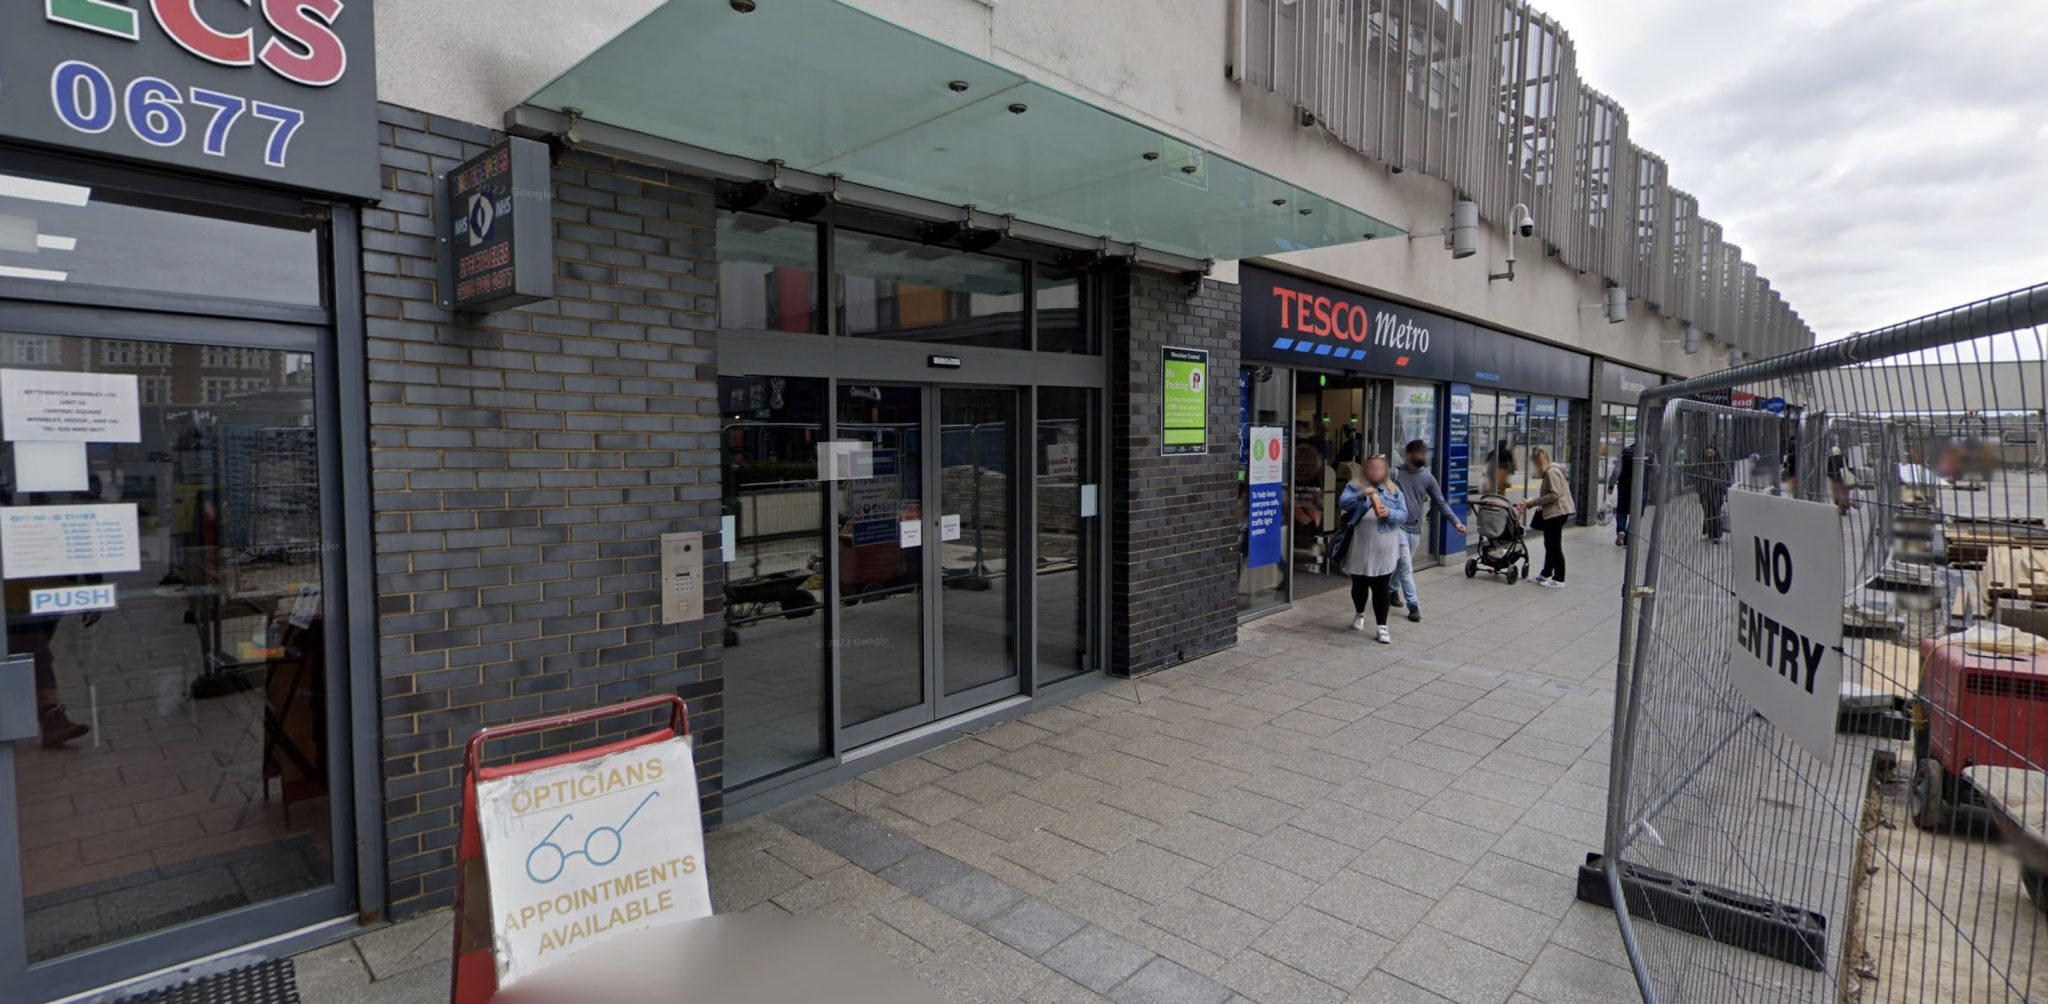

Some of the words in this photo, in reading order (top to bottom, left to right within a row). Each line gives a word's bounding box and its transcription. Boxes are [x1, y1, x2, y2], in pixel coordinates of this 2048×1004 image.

[51, 60, 304, 168] 0677
[454, 217, 468, 236] NHS
[495, 196, 512, 218] NHS
[1272, 286, 1368, 343] TESCO
[1374, 311, 1430, 354] Metro
[1754, 535, 1793, 595] NO
[34, 588, 110, 610] PUSH
[1737, 599, 1825, 695] ENTRY
[511, 758, 664, 815] OPTICIANS
[503, 855, 697, 935] APPOINTMENTS
[538, 888, 674, 956] AVAILABLE
